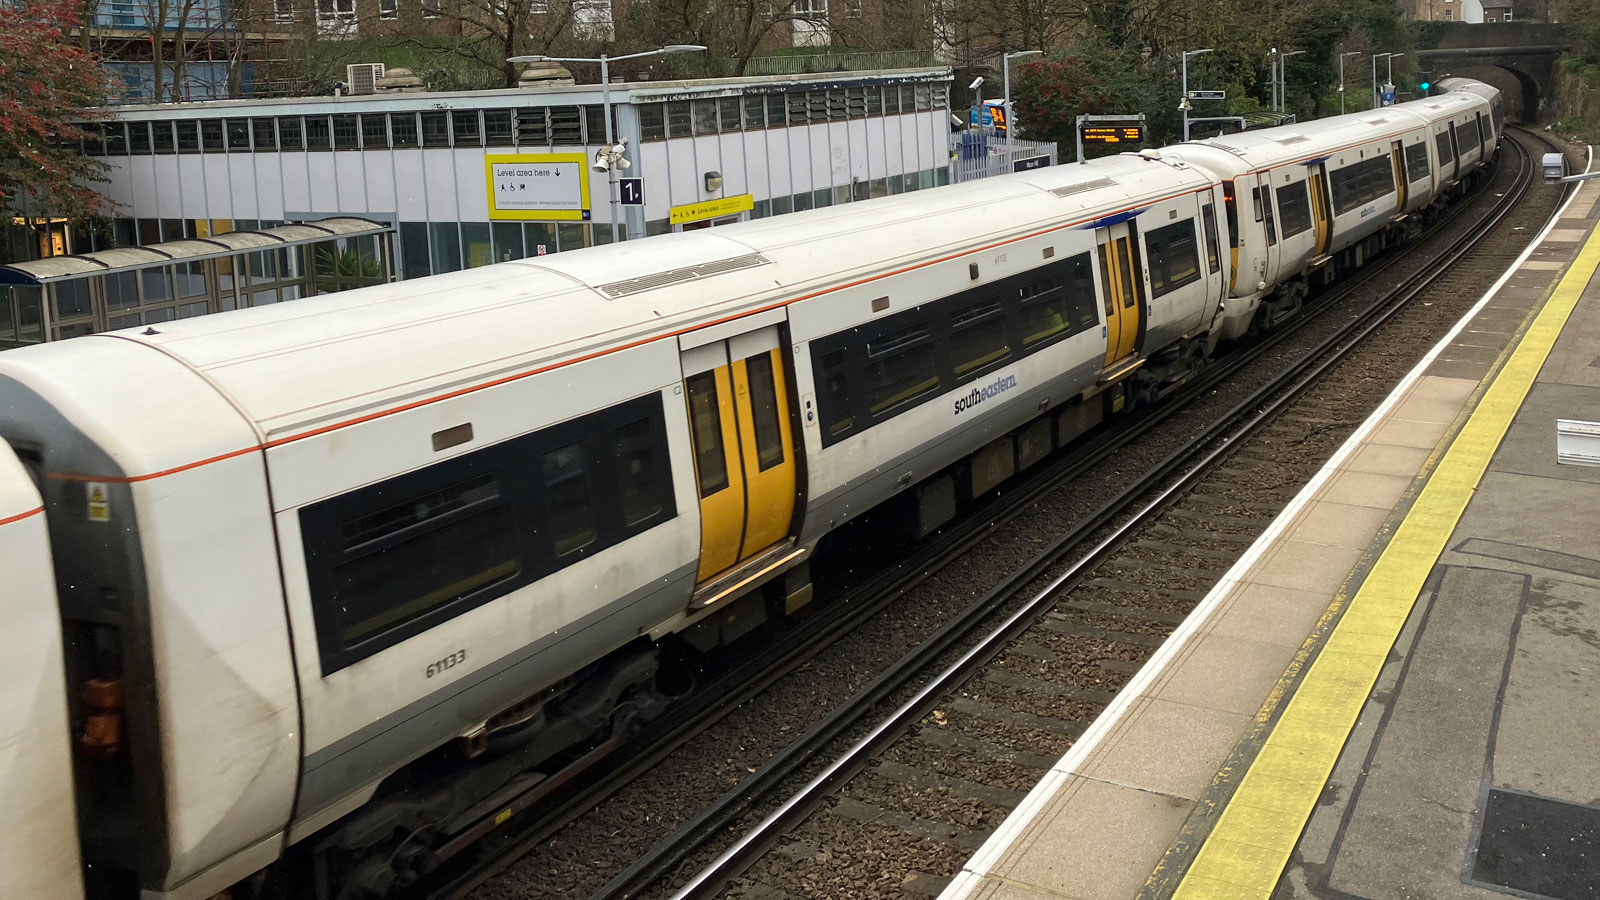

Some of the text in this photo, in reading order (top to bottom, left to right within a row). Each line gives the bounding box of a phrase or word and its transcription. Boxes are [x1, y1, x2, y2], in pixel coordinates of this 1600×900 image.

[497, 168, 515, 177] Level
[534, 168, 551, 176] here
[625, 182, 633, 201] 1
[426, 649, 465, 679] 61133
